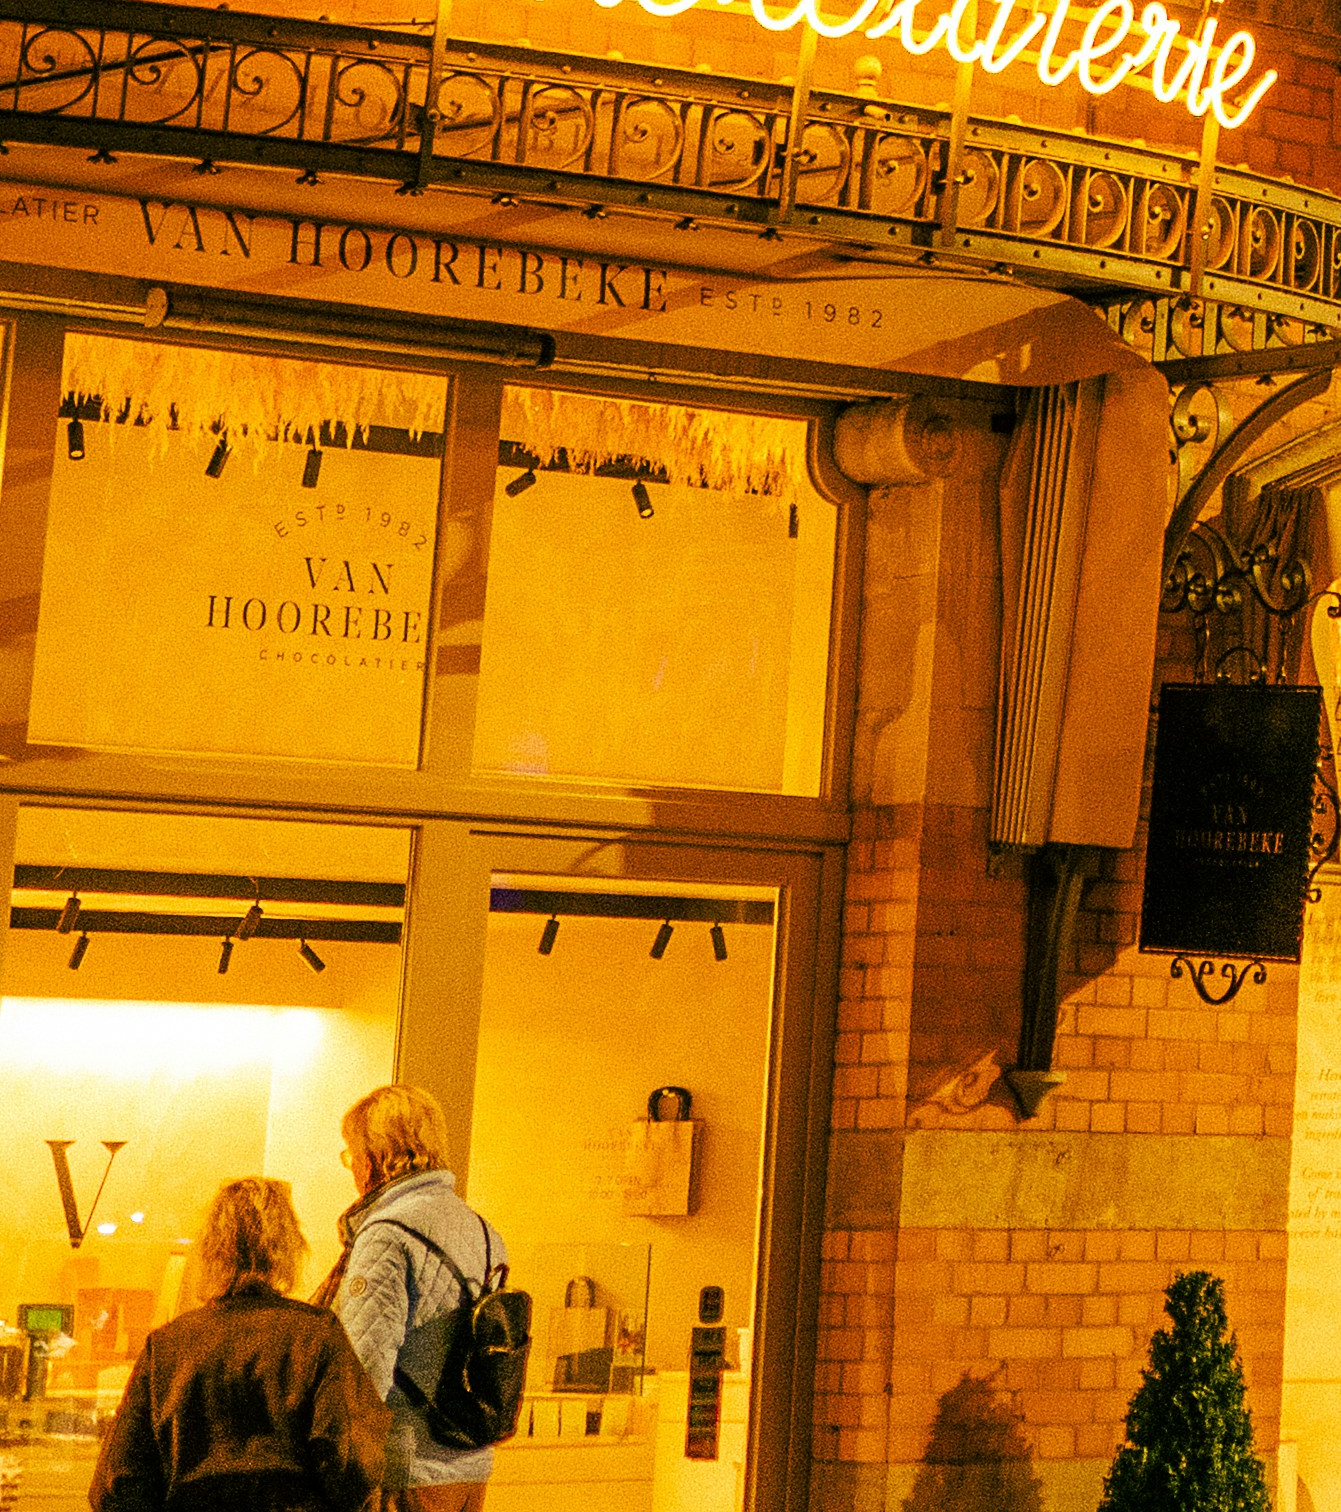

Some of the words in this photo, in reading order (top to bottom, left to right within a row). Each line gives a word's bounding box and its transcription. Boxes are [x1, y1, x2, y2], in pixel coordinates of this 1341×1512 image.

[138, 198, 259, 259] VAN
[288, 219, 668, 313] HOOREBEKE
[804, 301, 883, 330] 1982
[365, 507, 428, 551] 1982
[304, 557, 394, 595] VAN
[207, 594, 422, 644] HOOREBE
[44, 1139, 129, 1250] V
